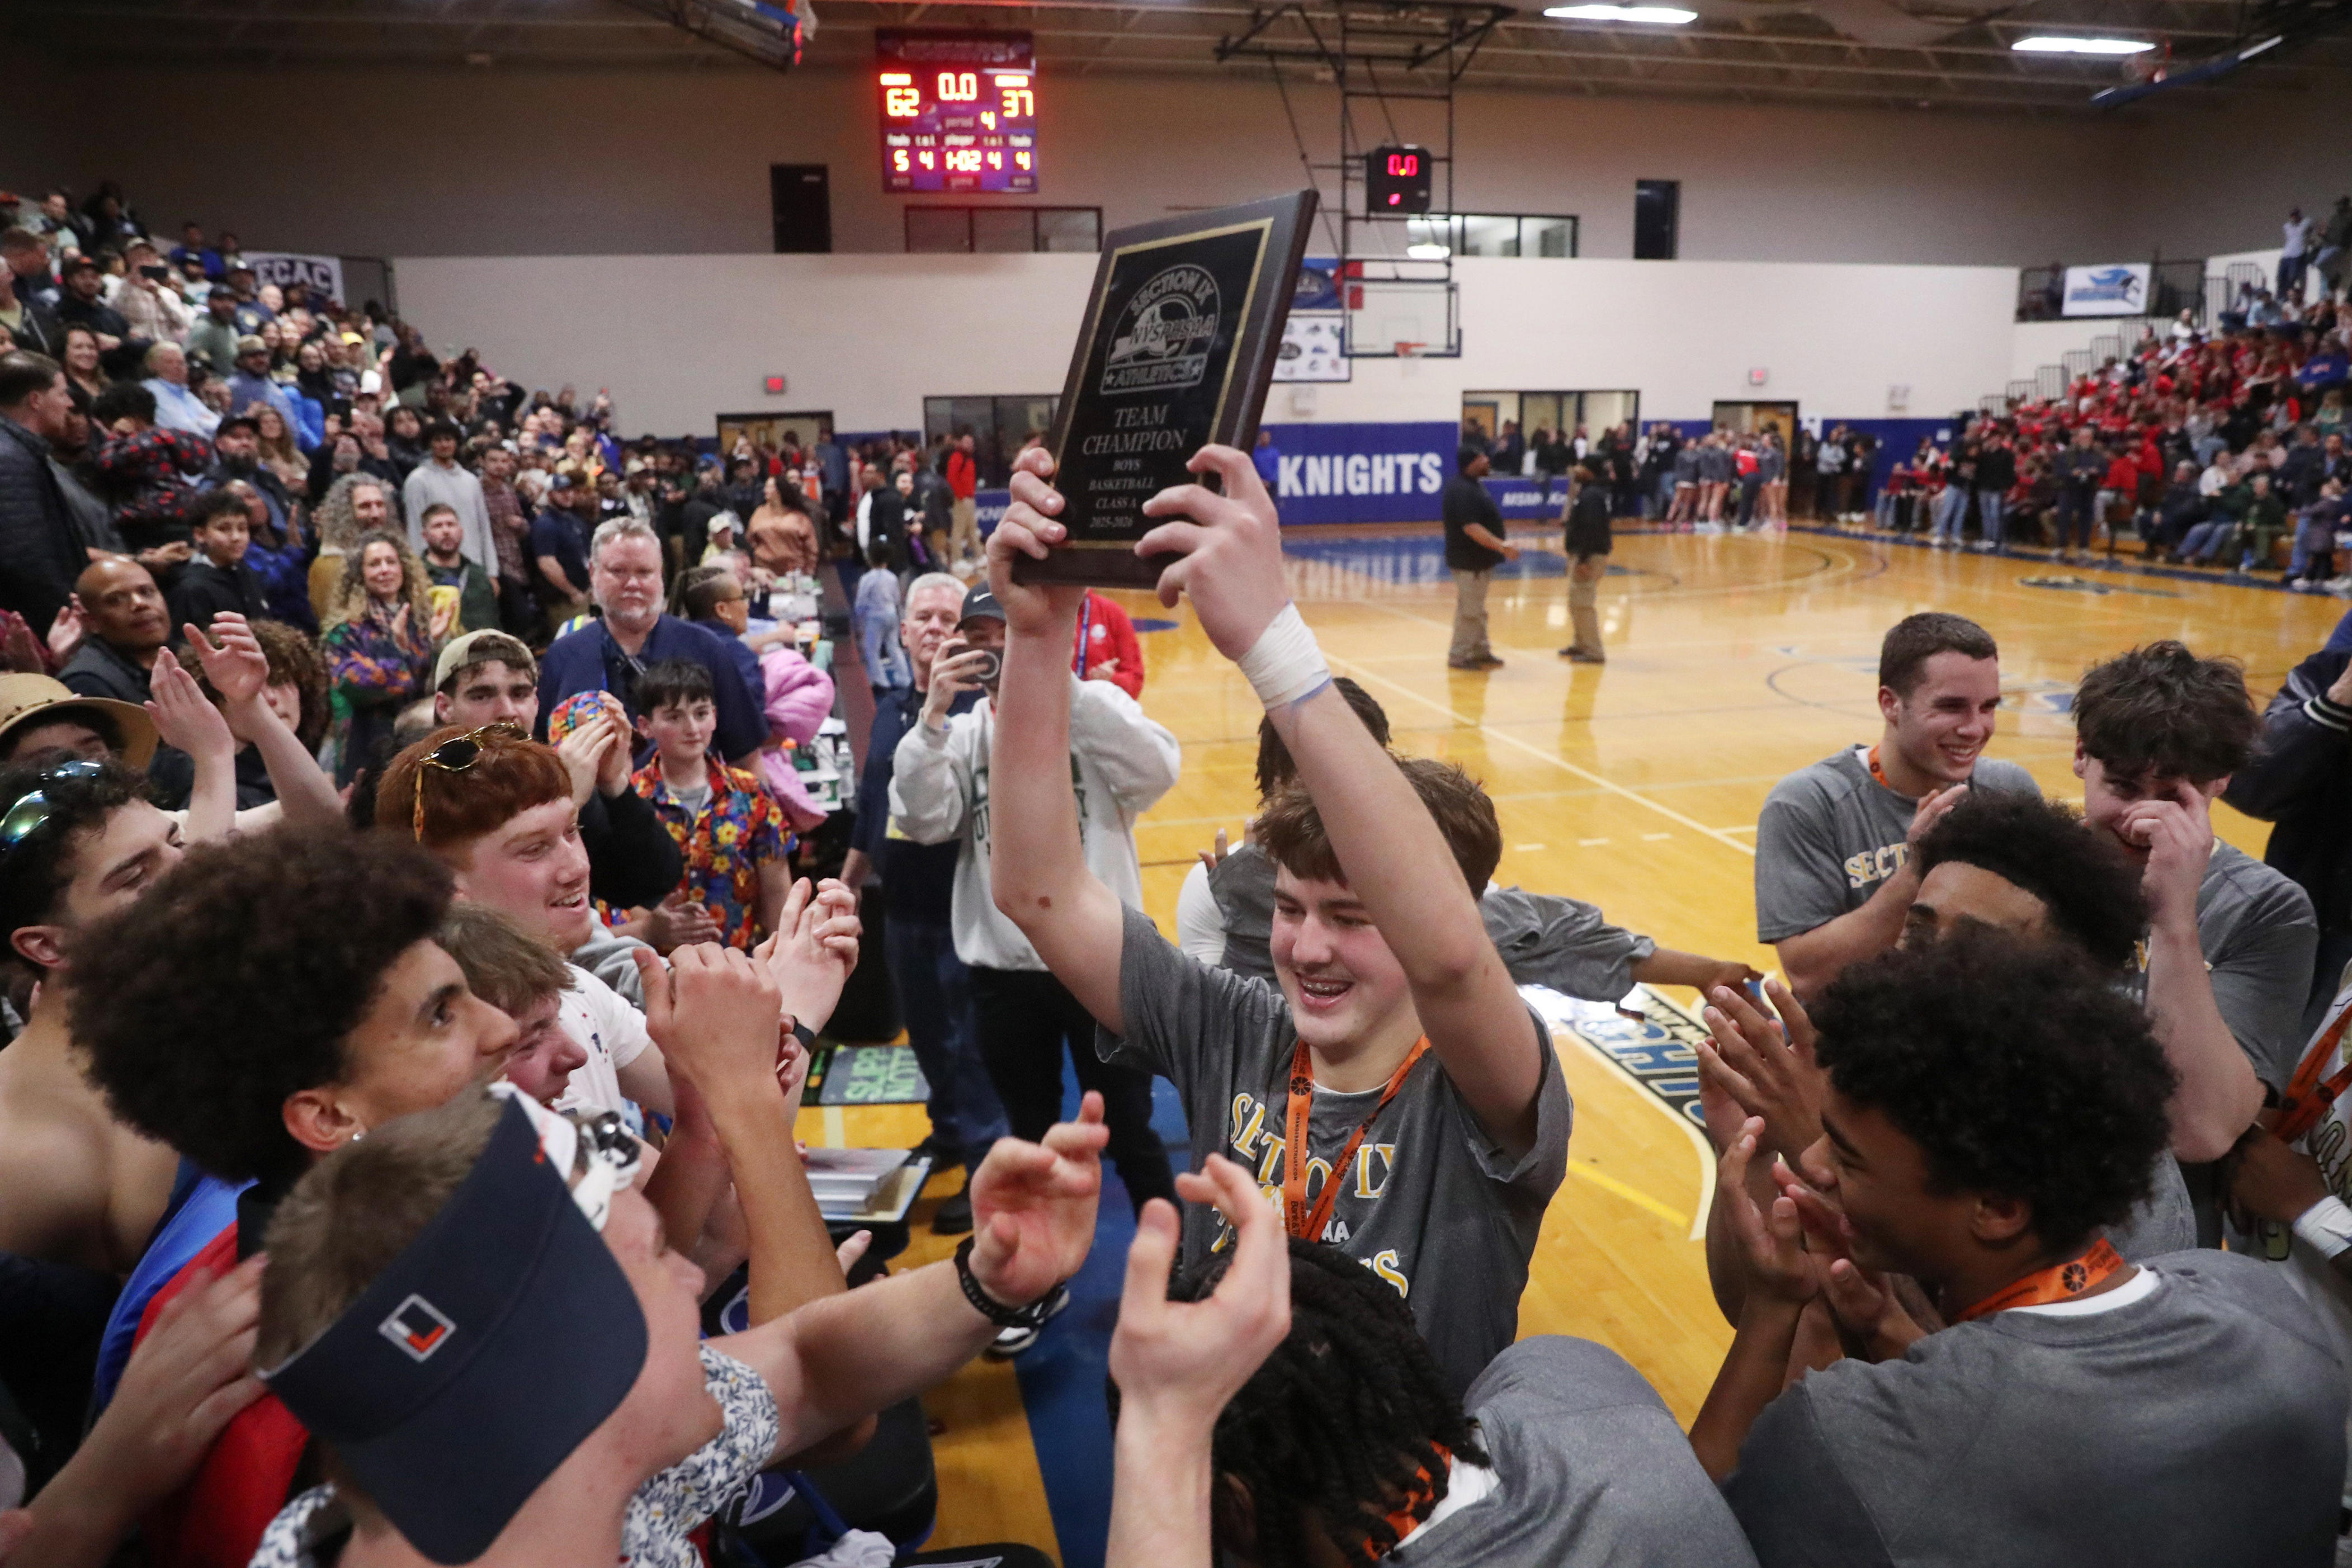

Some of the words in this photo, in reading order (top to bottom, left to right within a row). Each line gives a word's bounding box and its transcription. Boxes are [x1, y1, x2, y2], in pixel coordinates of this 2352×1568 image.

[938, 73, 977, 101] 0.0
[886, 88, 919, 116] 62
[1002, 89, 1033, 117] 37
[980, 111, 995, 130] 4
[894, 149, 909, 171] 5
[919, 151, 934, 169] 4
[987, 151, 1002, 170] 4
[1016, 151, 1031, 170] 4
[1387, 154, 1418, 177] 0.0
[1130, 270, 1201, 317] SECTION
[1114, 404, 1169, 428] TEAM
[1083, 429, 1188, 455] CHAMPION
[1113, 459, 1142, 471] BOYS
[1278, 453, 1443, 497] KNIGHTS
[1088, 477, 1155, 491] BASKETBALL
[1095, 497, 1127, 509] CLASS
[1844, 842, 1910, 889] SECT
